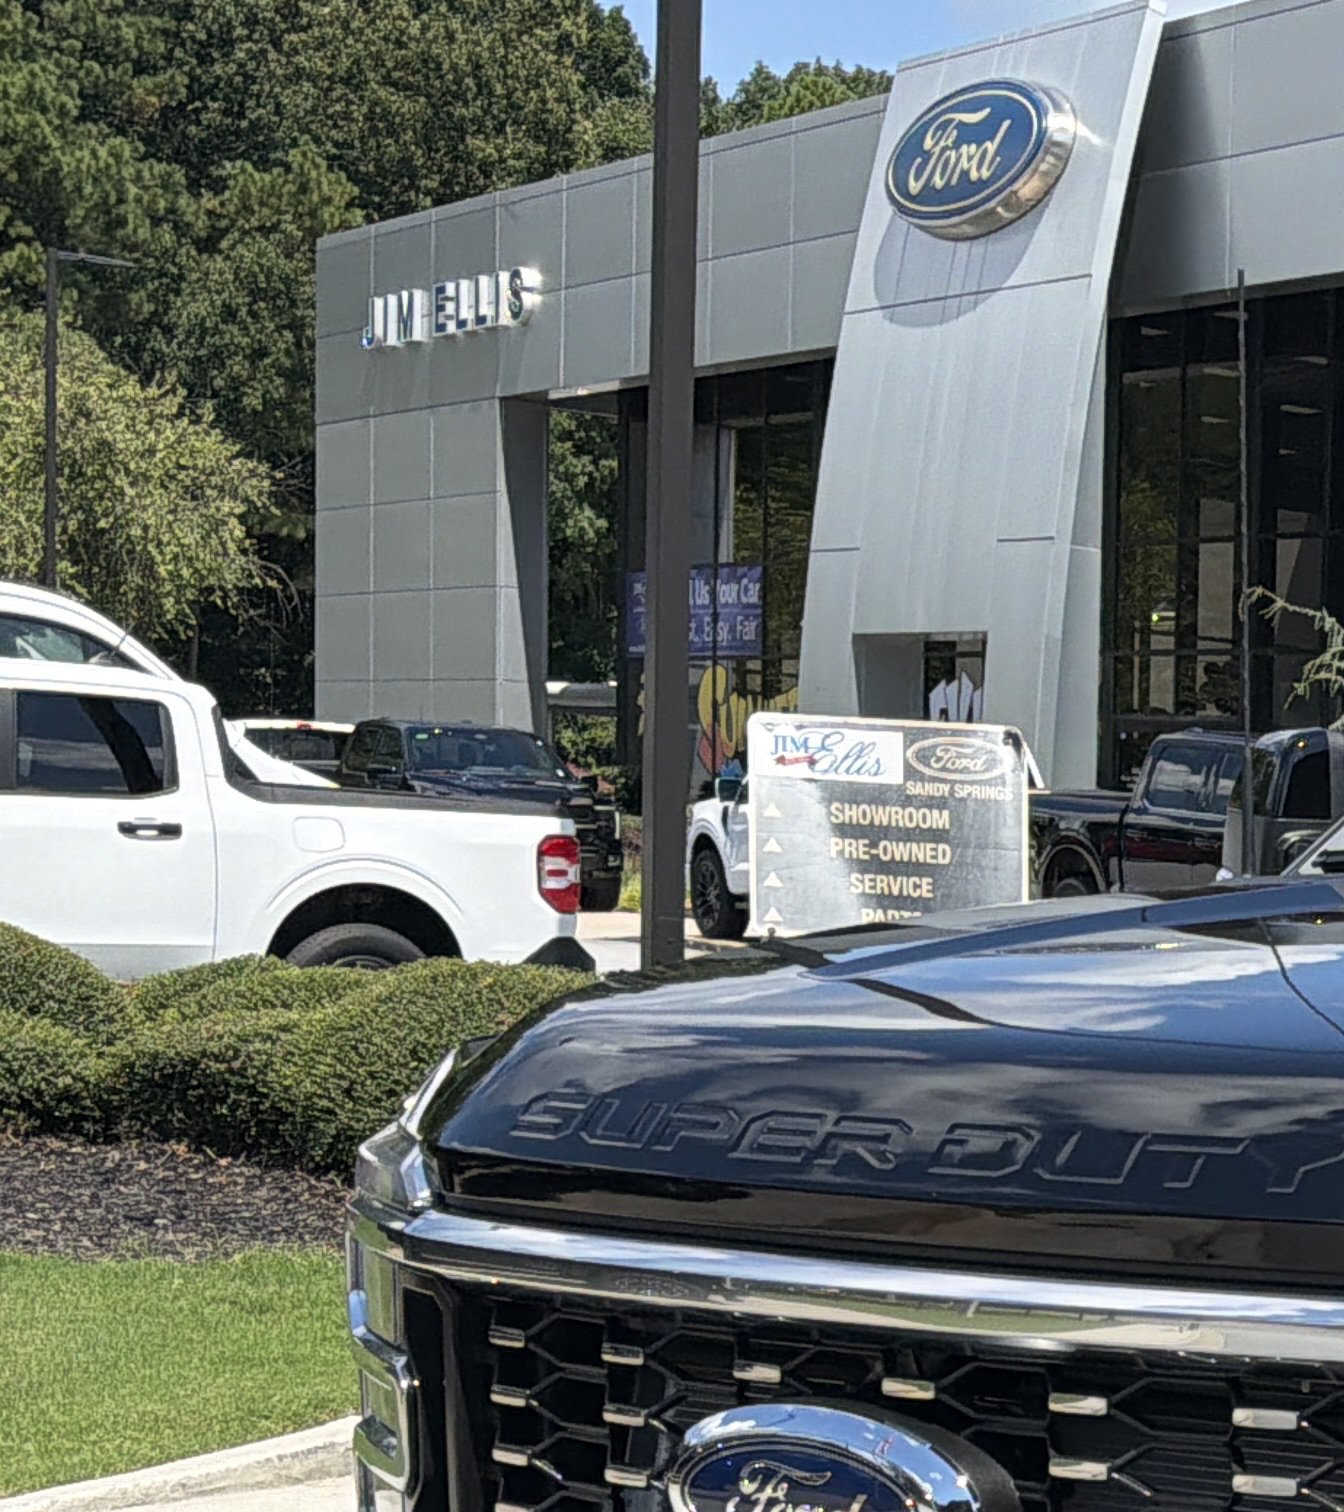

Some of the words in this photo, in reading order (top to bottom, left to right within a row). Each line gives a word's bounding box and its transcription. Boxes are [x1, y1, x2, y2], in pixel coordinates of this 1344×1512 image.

[908, 107, 1012, 197] Ford
[361, 287, 430, 349] JIM
[433, 266, 541, 337] ELLIS
[770, 734, 810, 756] JIM
[806, 731, 887, 777] Ellis
[930, 745, 987, 773] Ford
[905, 780, 951, 798] SANDY
[953, 783, 1014, 801] SPRINGS
[829, 802, 951, 830] SHOWROOM
[829, 837, 952, 865] PRE-OWNED
[849, 872, 935, 898] SERVICE
[860, 908, 923, 923] PAR
[509, 1085, 915, 1170] SUPER
